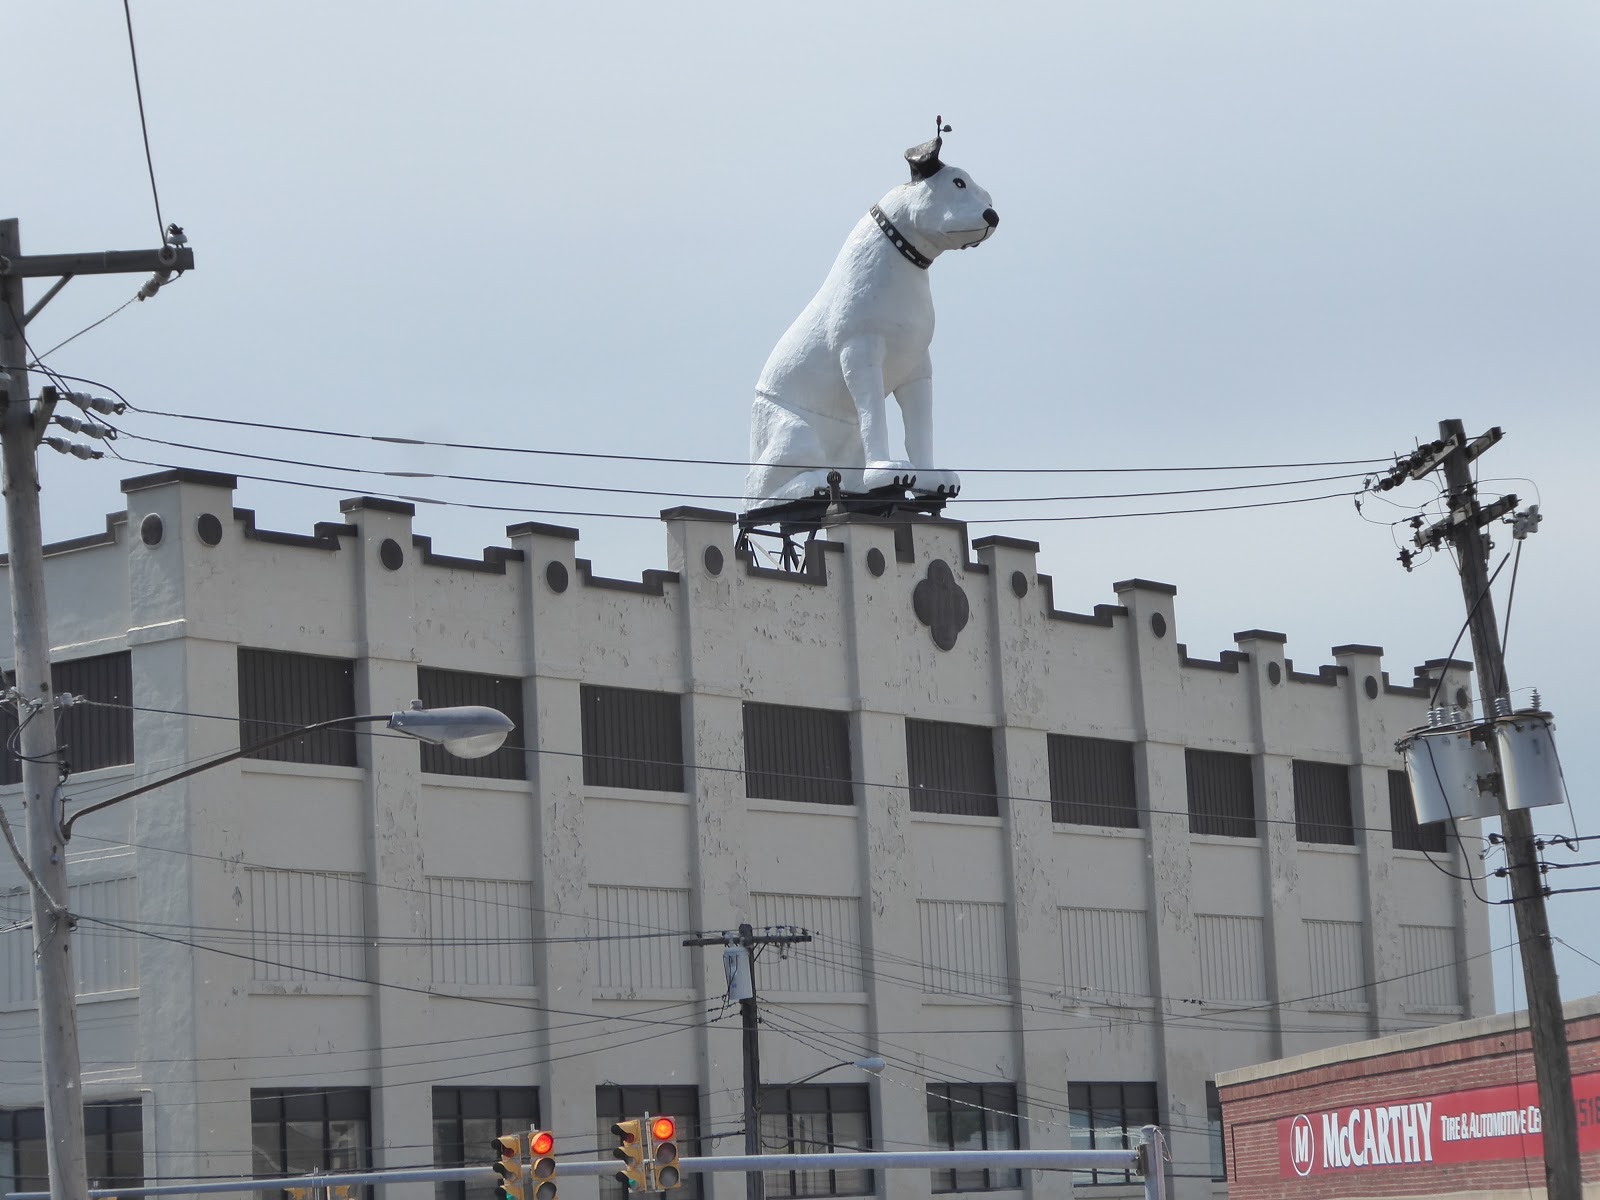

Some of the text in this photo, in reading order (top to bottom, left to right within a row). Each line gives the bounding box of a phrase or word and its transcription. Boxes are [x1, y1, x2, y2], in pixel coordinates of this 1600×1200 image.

[1528, 1105, 1542, 1133] CE
[1576, 1096, 1600, 1127] 518
[1295, 1126, 1309, 1163] M
[1322, 1102, 1433, 1168] McCARTHY
